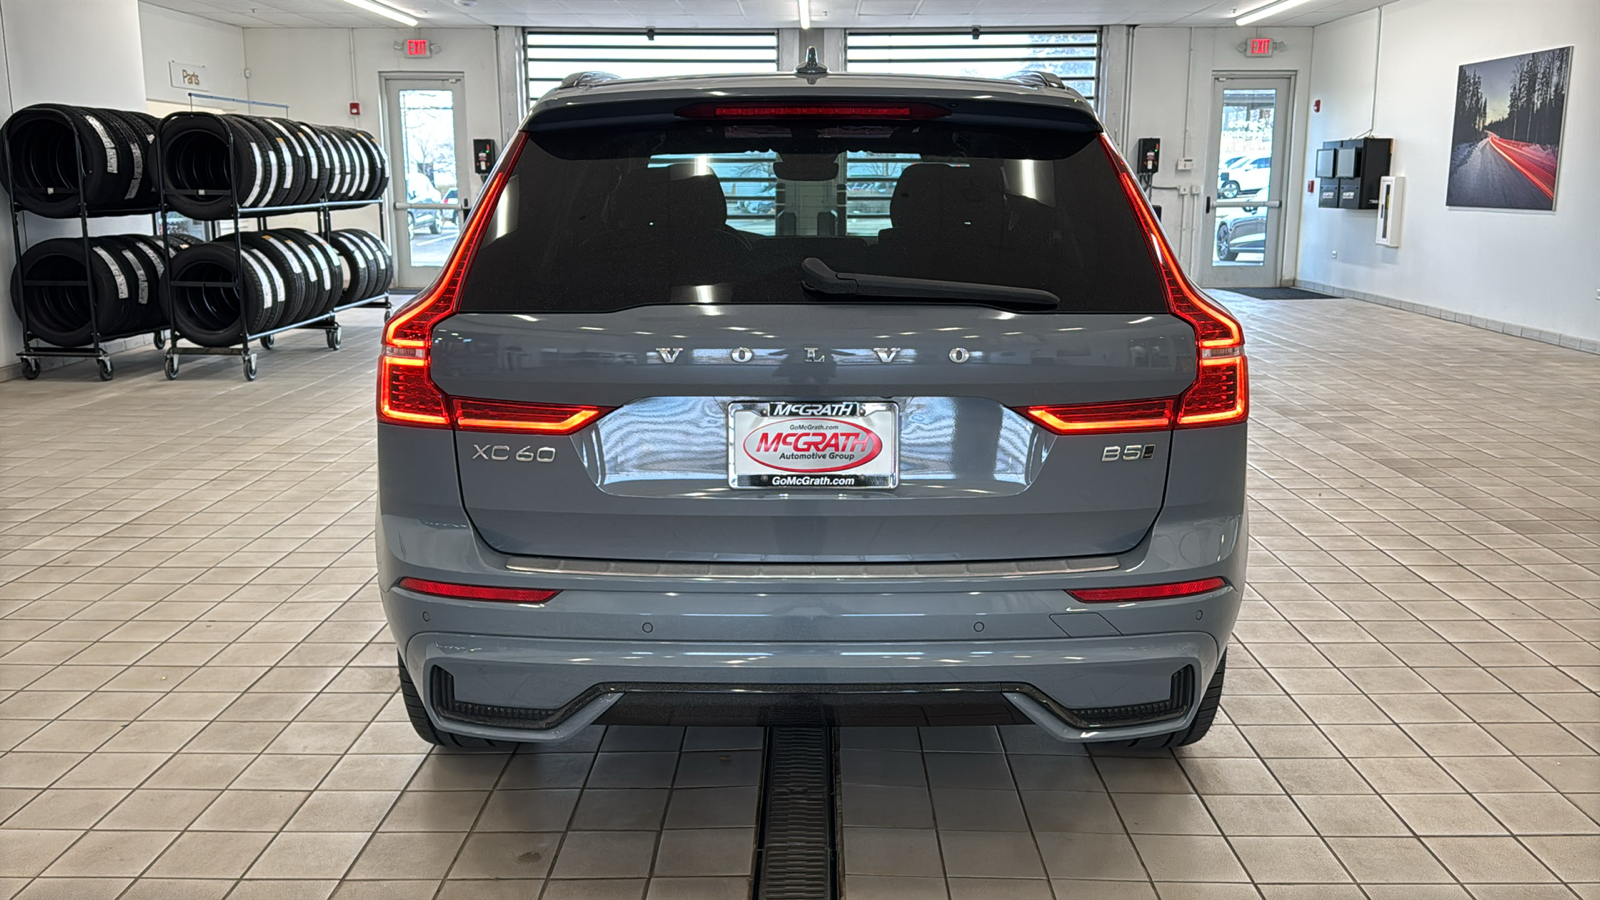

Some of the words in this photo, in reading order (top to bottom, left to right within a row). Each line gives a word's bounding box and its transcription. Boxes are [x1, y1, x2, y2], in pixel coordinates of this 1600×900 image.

[407, 39, 427, 55] EXIT
[1251, 39, 1270, 54] EXIT
[182, 69, 200, 86] Parts
[656, 347, 970, 364] VOLVO
[779, 452, 827, 460] Automotive
[828, 452, 855, 461] Group
[1101, 444, 1142, 462] B5
[771, 476, 855, 486] GoMcGrath.com
